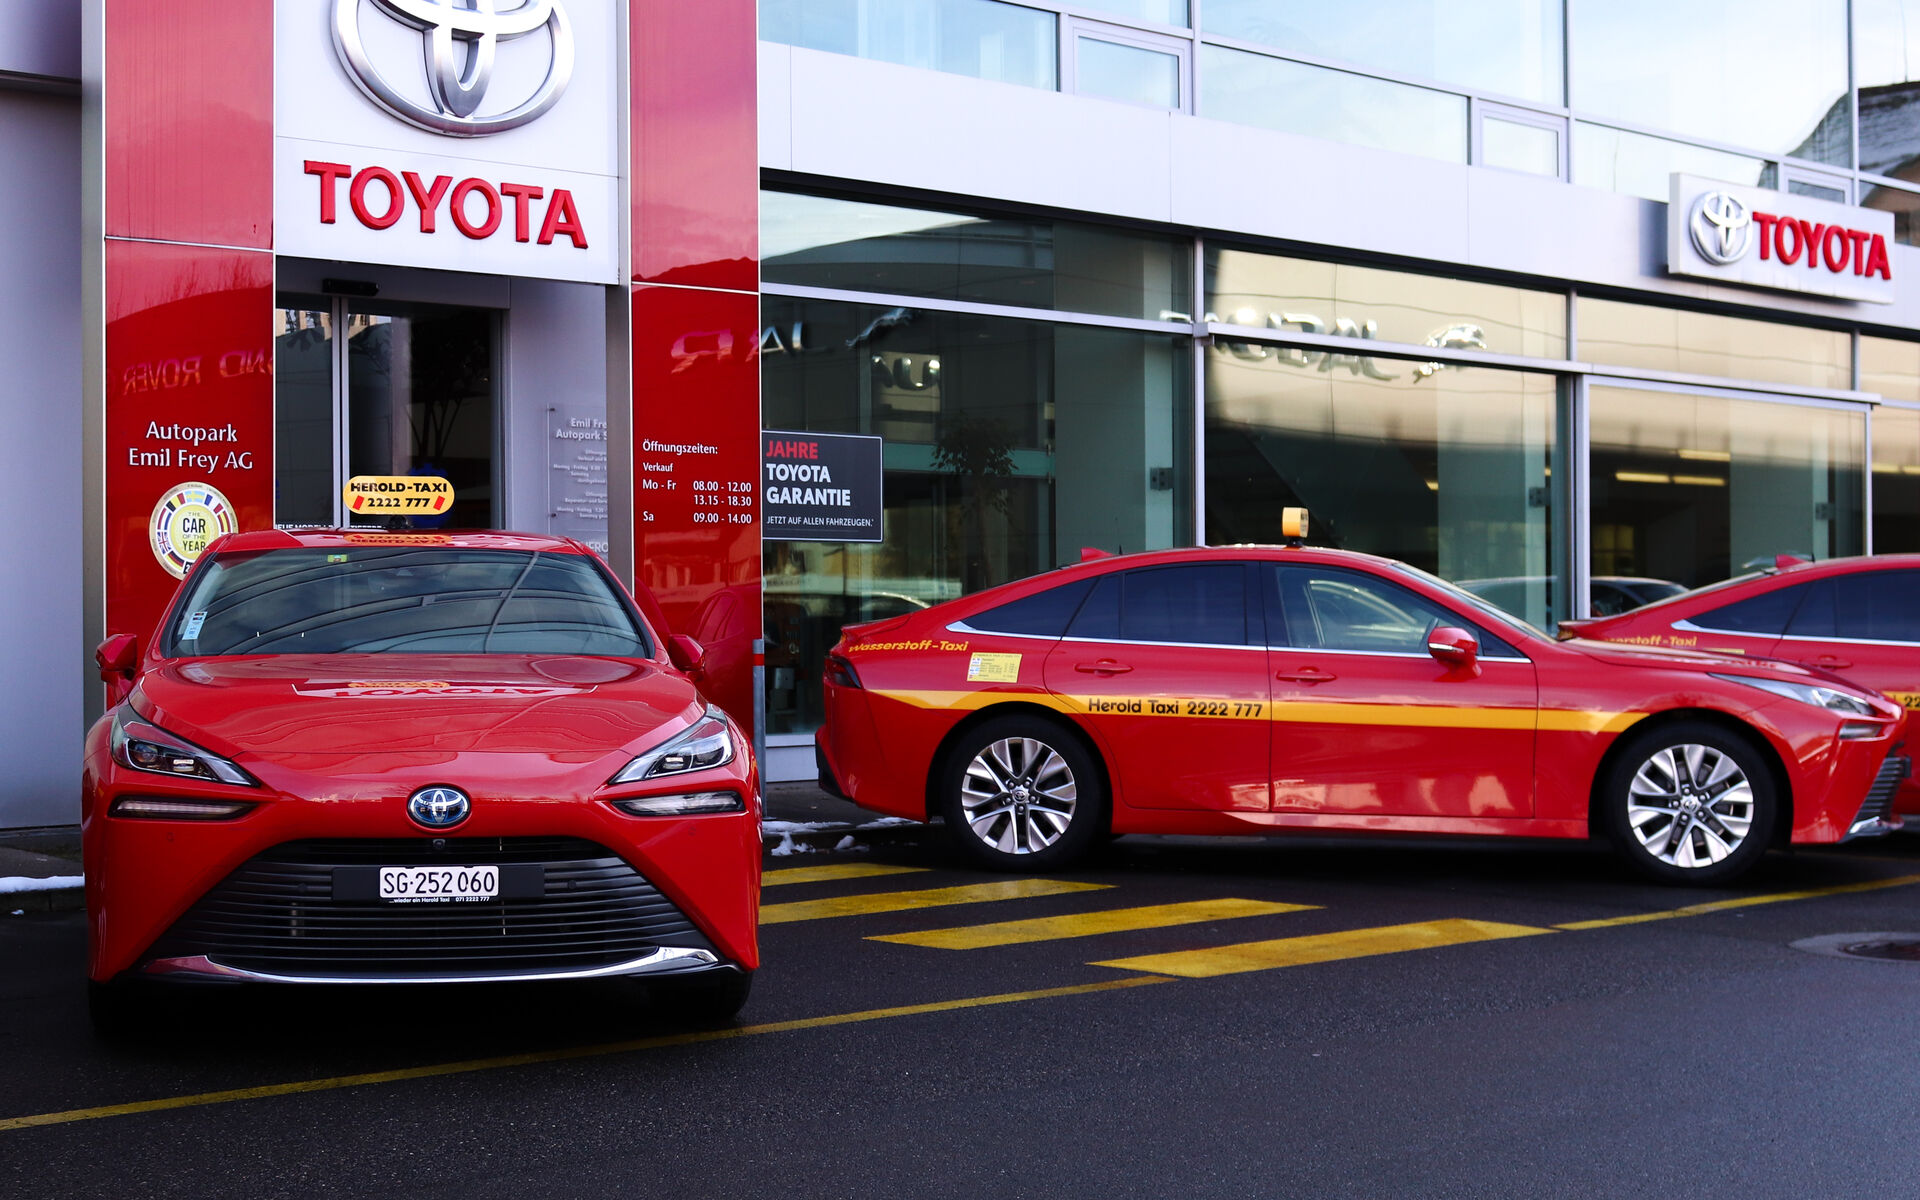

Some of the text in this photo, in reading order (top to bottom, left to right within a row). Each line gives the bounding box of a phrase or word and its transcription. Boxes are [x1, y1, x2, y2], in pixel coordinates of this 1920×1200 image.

[303, 160, 589, 249] TOYOTA
[1752, 211, 1891, 280] TOYOTA
[145, 421, 238, 446] Autopark
[556, 428, 600, 441] Autopark
[642, 439, 718, 455] Öffnungszeiten:
[766, 440, 819, 459] JAHRE
[128, 448, 253, 474] Emil Frey AG
[642, 462, 674, 472] Verkauf
[766, 463, 831, 483] TOYOTA
[351, 482, 447, 493] HEROLD-TAXI
[642, 479, 659, 490] Mo
[667, 480, 677, 490] Fr
[693, 480, 719, 491] 08.00
[727, 482, 752, 492] 12.00
[367, 497, 431, 508] 2222 777
[694, 494, 719, 505] 13.15
[727, 496, 752, 506] 18.30
[766, 486, 851, 507] GARANTIE
[643, 510, 654, 521] Sa
[693, 512, 719, 523] 09.00
[727, 513, 752, 524] 14.00
[766, 516, 786, 525] JETZT
[787, 516, 802, 525] AUF
[803, 517, 825, 526] ALLEN
[182, 517, 206, 534] CAR
[182, 541, 206, 552] YEAR
[1088, 698, 1263, 717] Herold Taxi 2222 777
